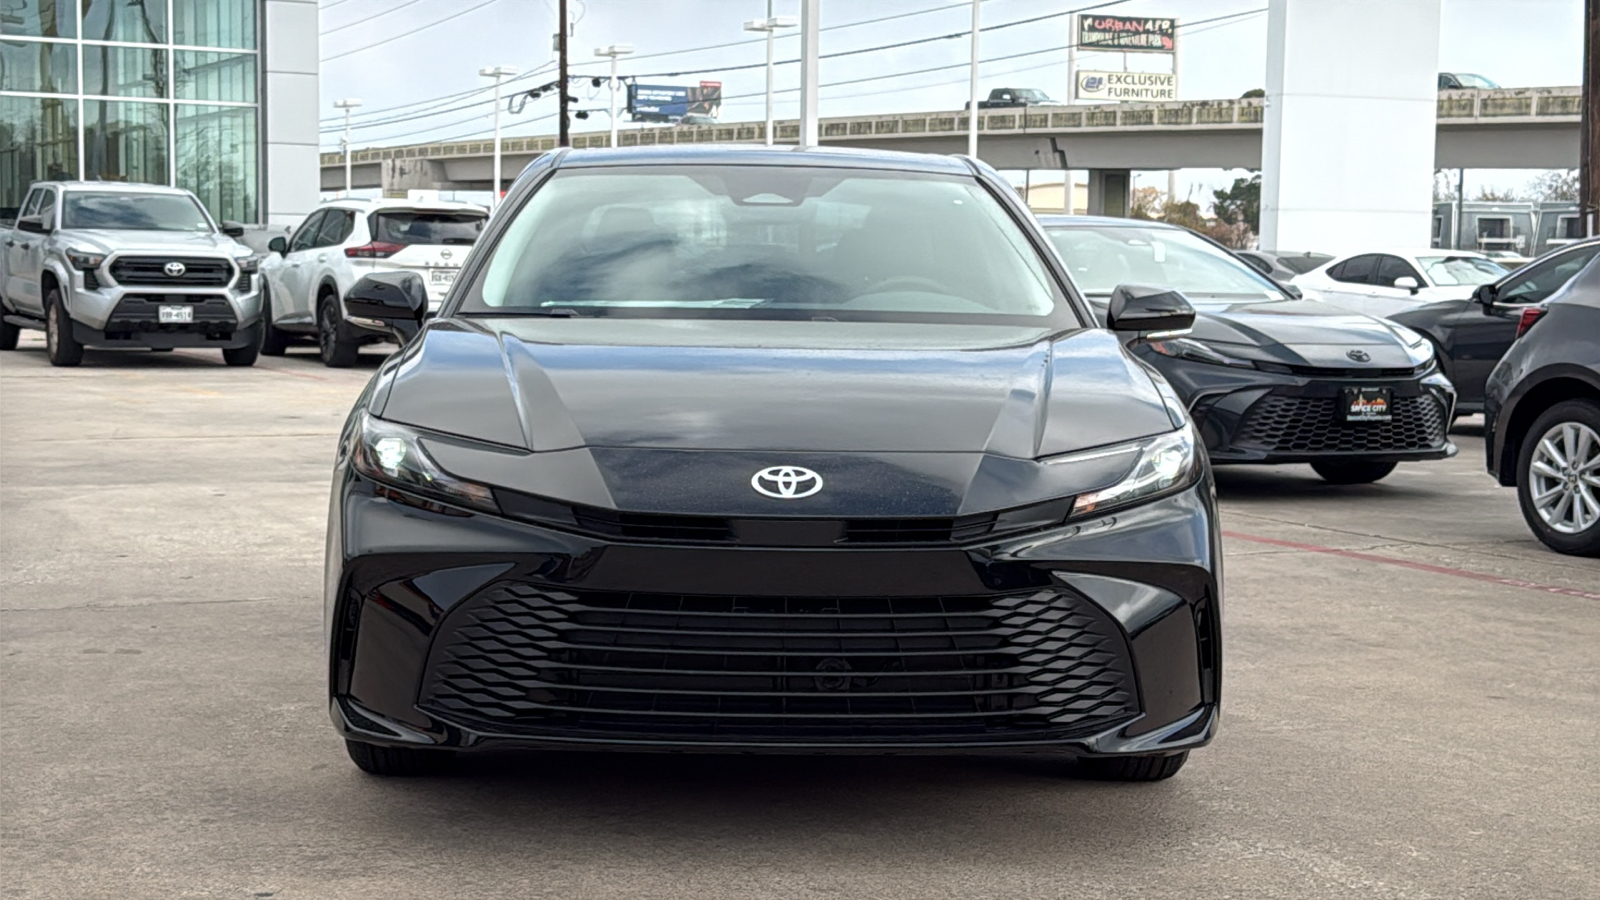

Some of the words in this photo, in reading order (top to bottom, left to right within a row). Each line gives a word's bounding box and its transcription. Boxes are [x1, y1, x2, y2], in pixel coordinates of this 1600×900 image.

[1094, 17, 1144, 32] URBAN
[1107, 74, 1174, 87] EXCLUSIVE
[1107, 87, 1174, 99] FURNITURE
[1372, 404, 1387, 412] CITY
